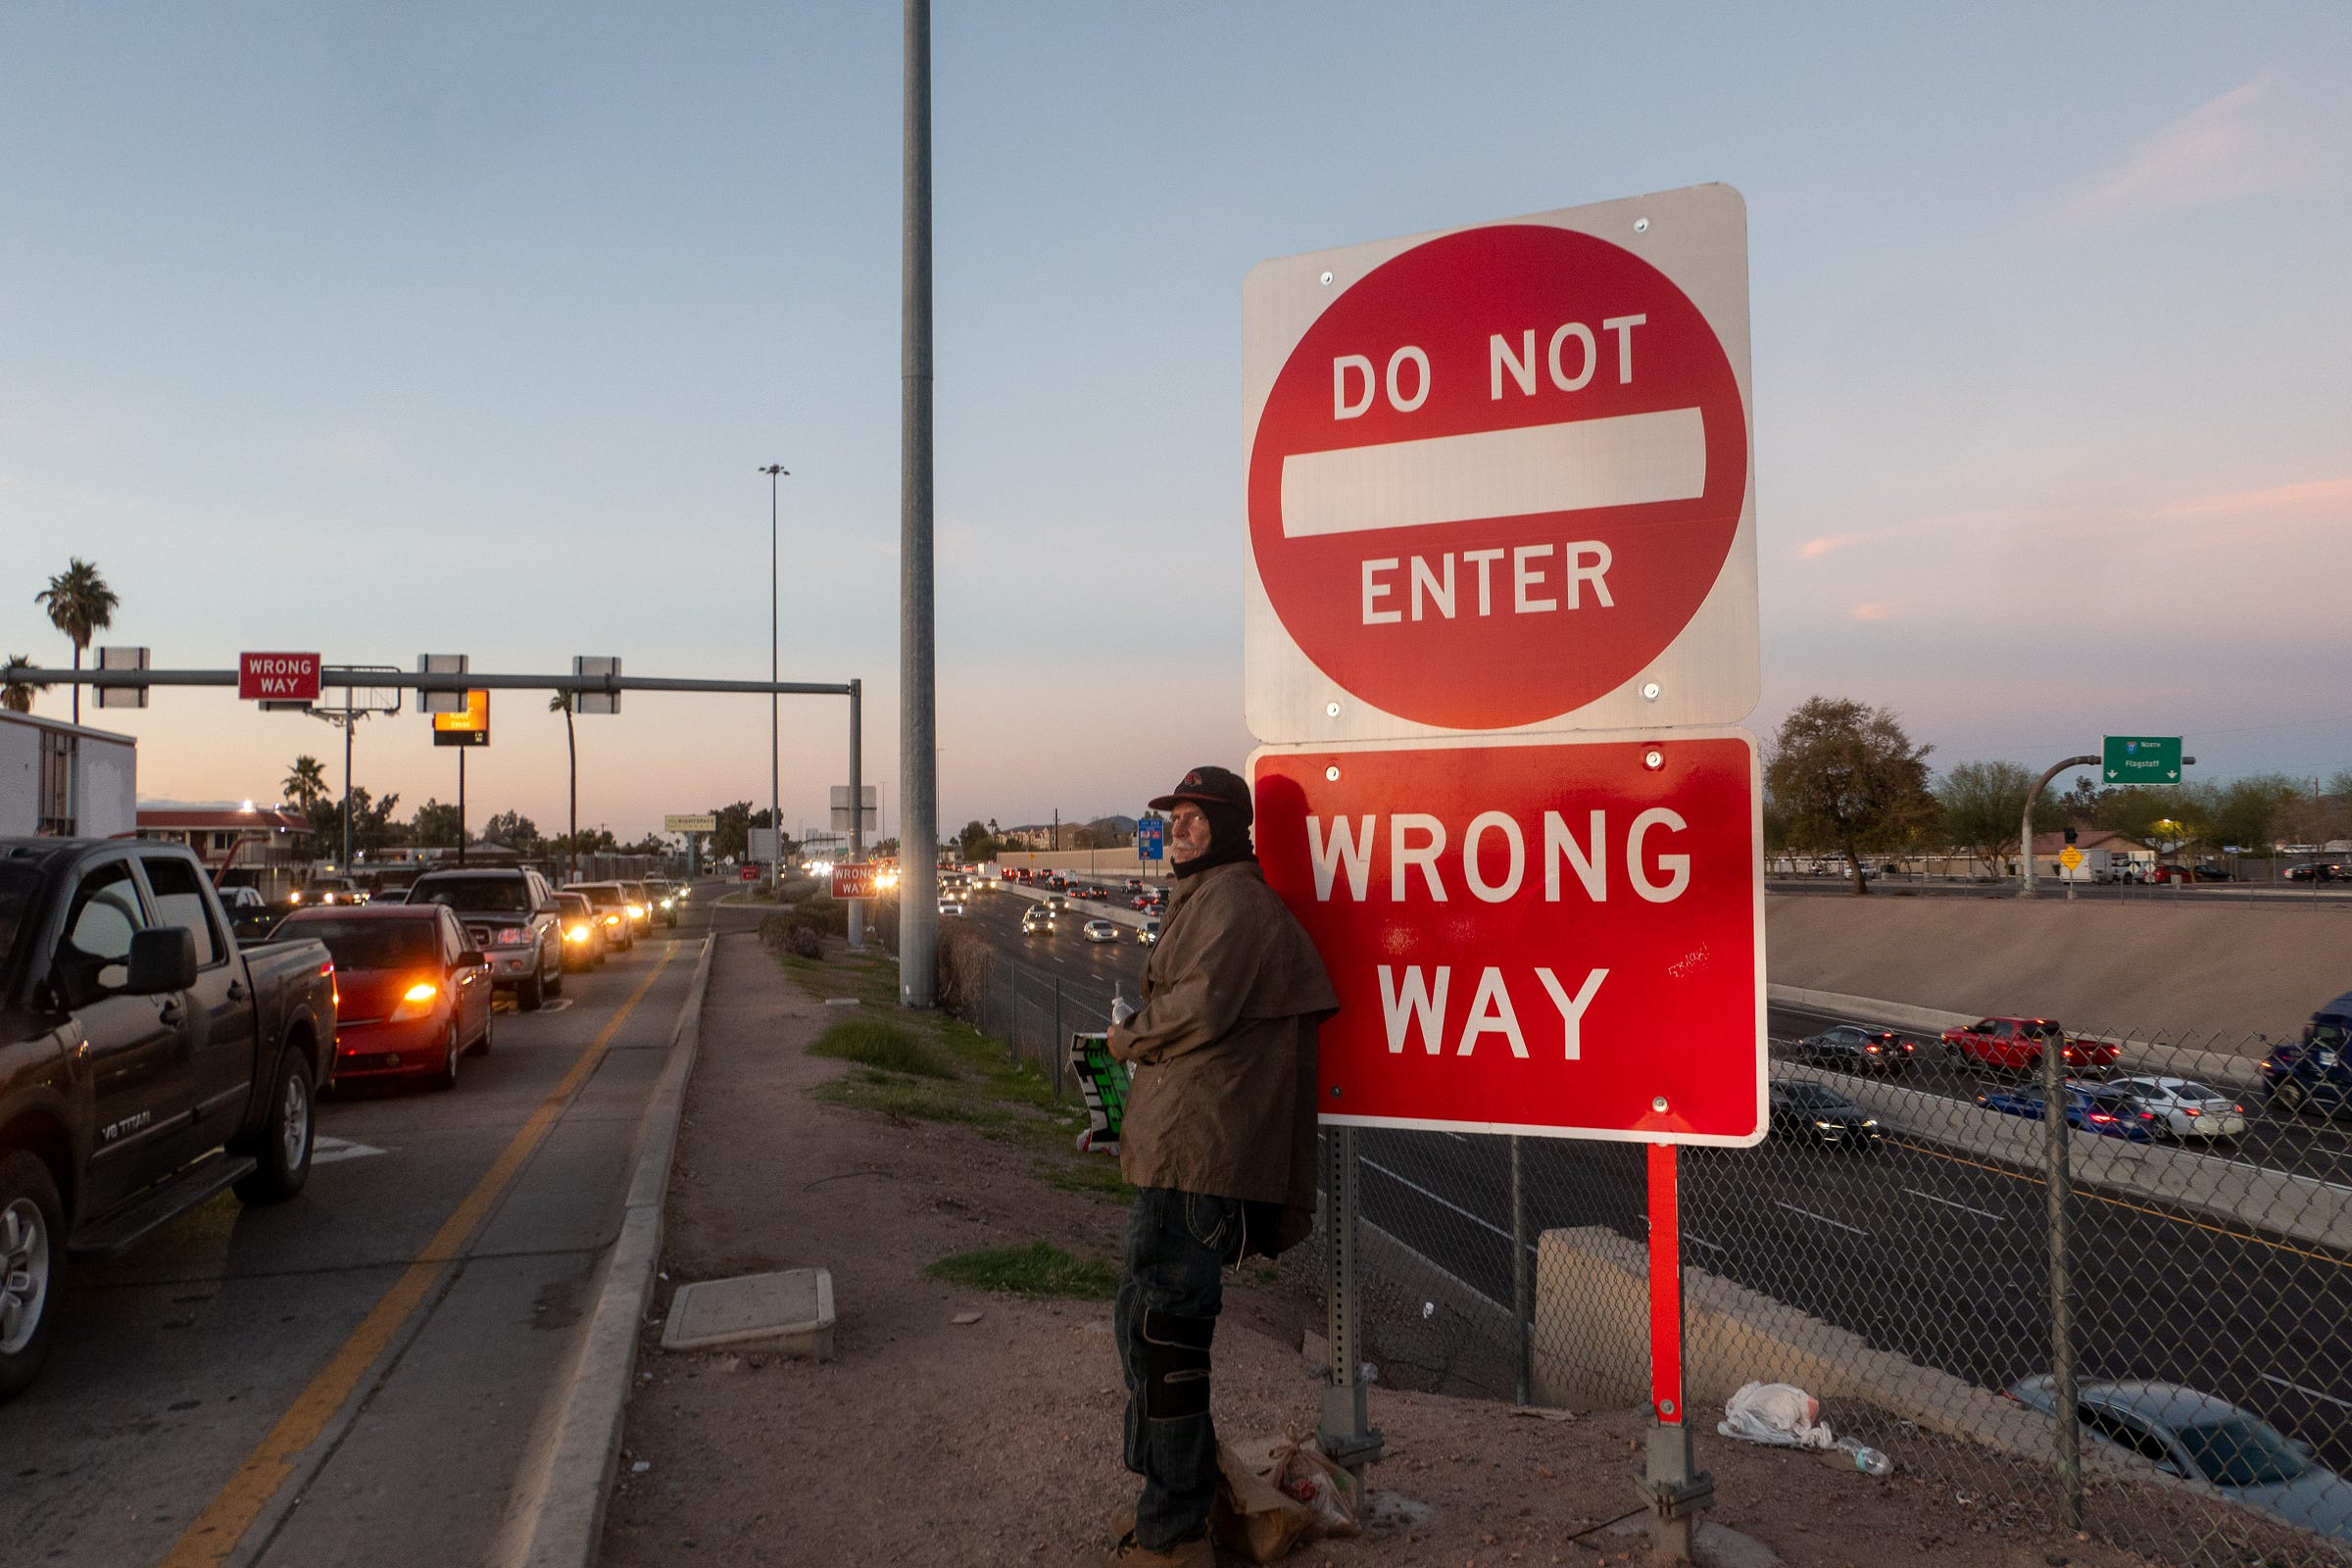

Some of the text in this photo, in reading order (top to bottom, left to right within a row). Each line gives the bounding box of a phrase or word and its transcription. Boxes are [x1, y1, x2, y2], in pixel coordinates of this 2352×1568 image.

[1333, 313, 1646, 421] DO NOT
[1361, 540, 1615, 625] ENTER
[250, 659, 312, 675] WRONG
[261, 677, 299, 693] WAY
[2125, 760, 2160, 769] Flagstaff
[1305, 807, 1690, 904] WRONG
[835, 867, 876, 880] WRONG
[843, 882, 866, 894] WAY
[1377, 964, 1610, 1060] WAY
[102, 1110, 150, 1140] V8 TITAN
